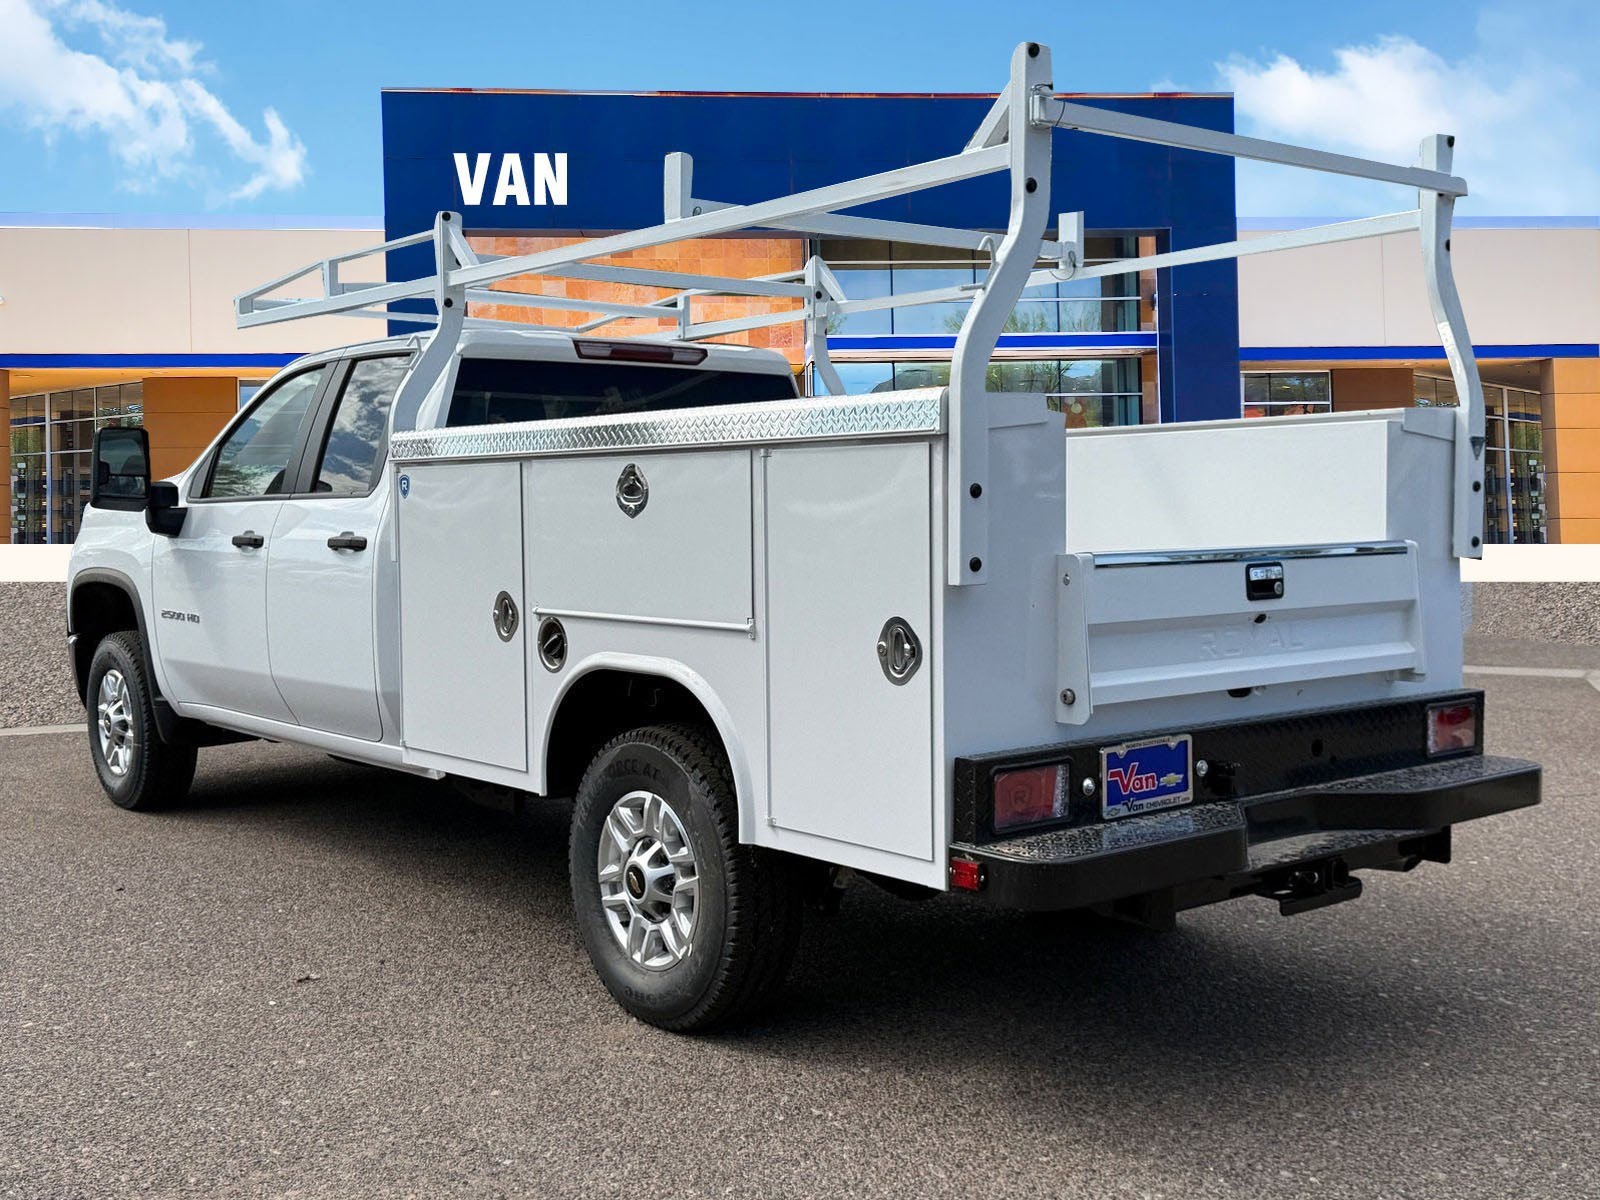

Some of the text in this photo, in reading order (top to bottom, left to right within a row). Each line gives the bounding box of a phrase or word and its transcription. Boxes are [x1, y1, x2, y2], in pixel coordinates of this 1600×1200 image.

[453, 153, 568, 206] VAN
[161, 609, 200, 624] 2500 HD
[1108, 762, 1158, 794] Van
[1122, 798, 1144, 812] Van
[1146, 796, 1181, 808] CHEVROLET
